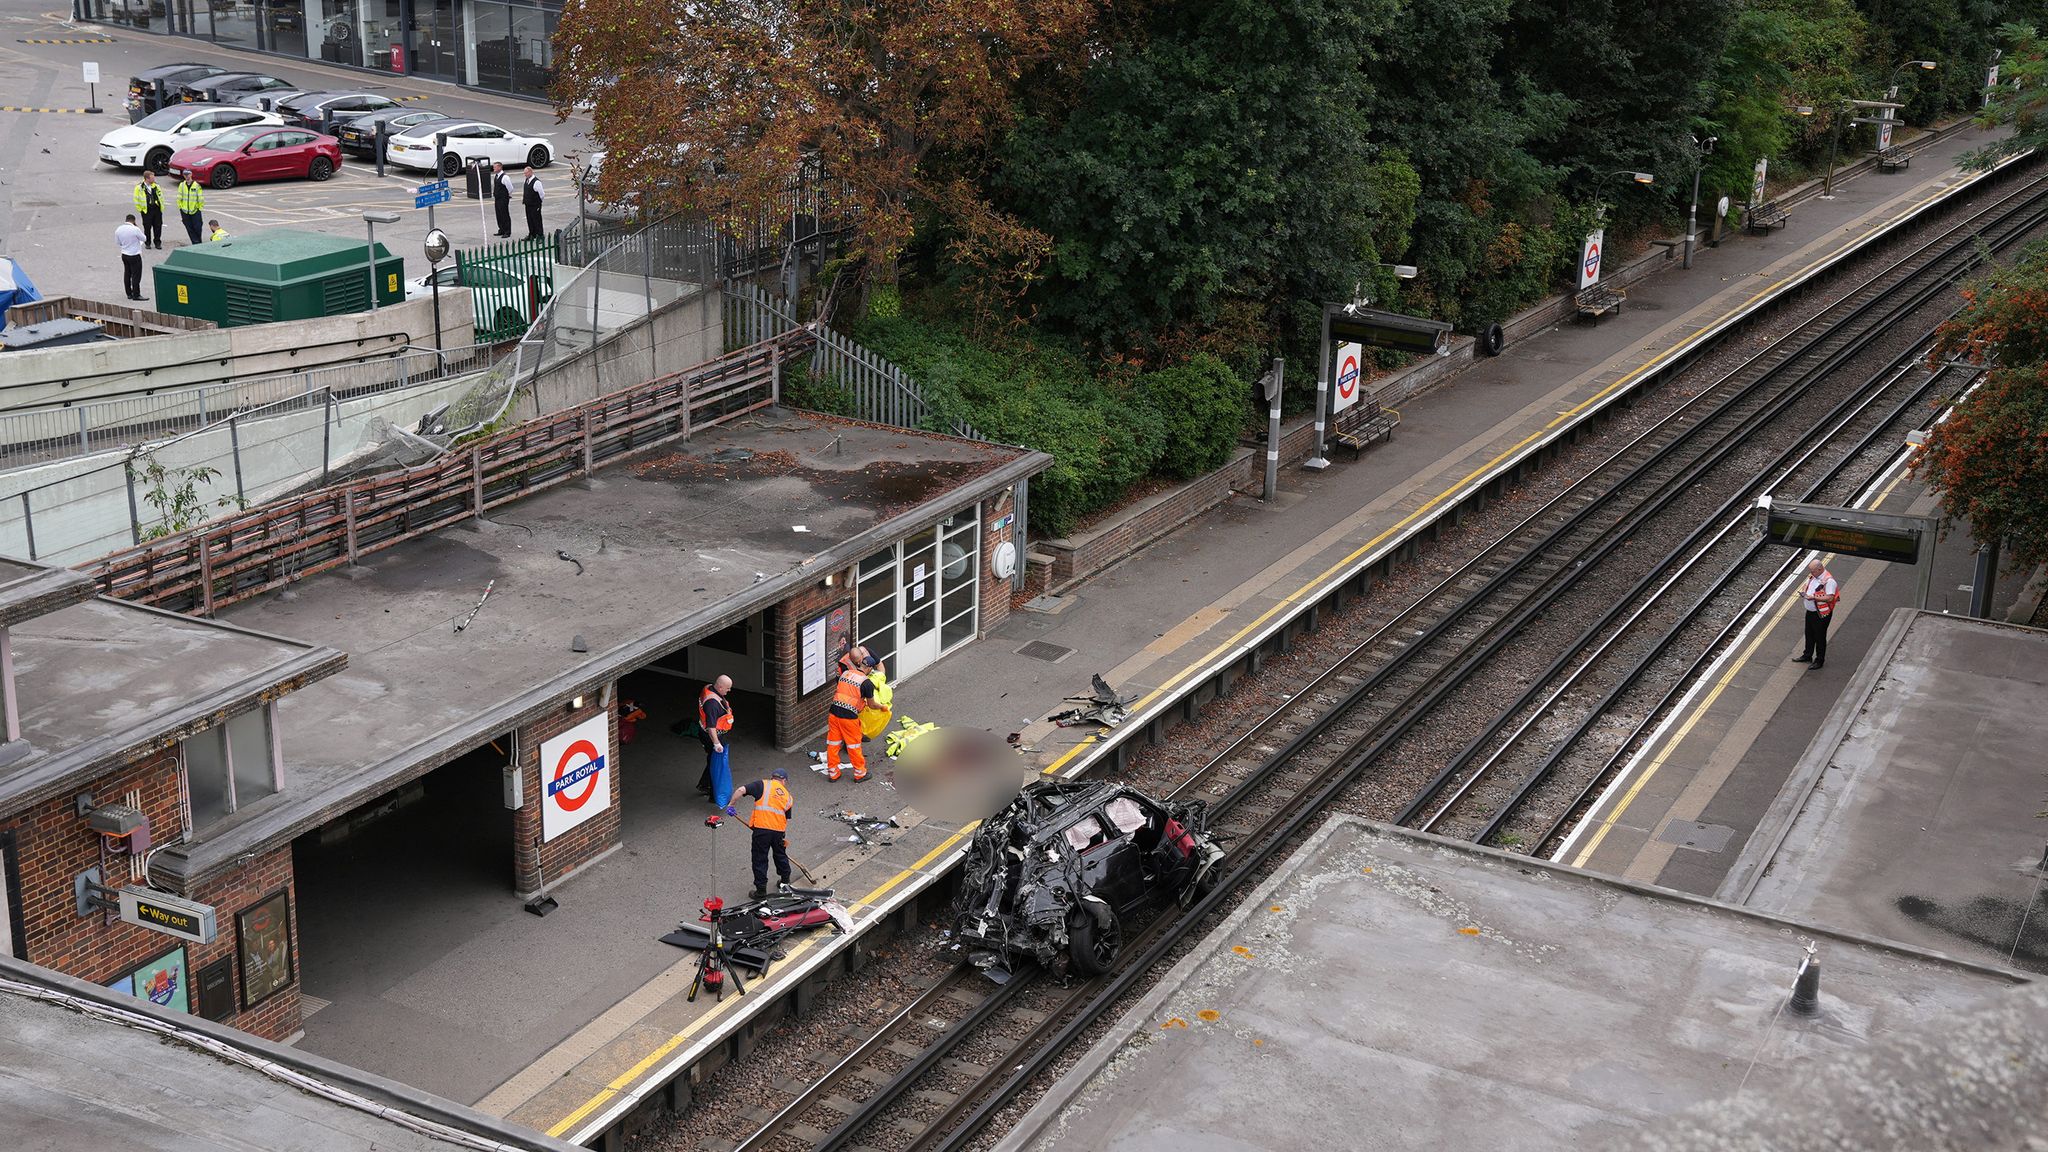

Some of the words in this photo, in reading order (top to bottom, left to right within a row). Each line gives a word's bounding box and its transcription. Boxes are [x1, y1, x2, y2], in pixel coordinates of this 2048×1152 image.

[555, 776, 574, 790] PARK
[576, 762, 598, 779] ROYAL
[150, 908, 170, 923] Way
[171, 917, 188, 927] out
